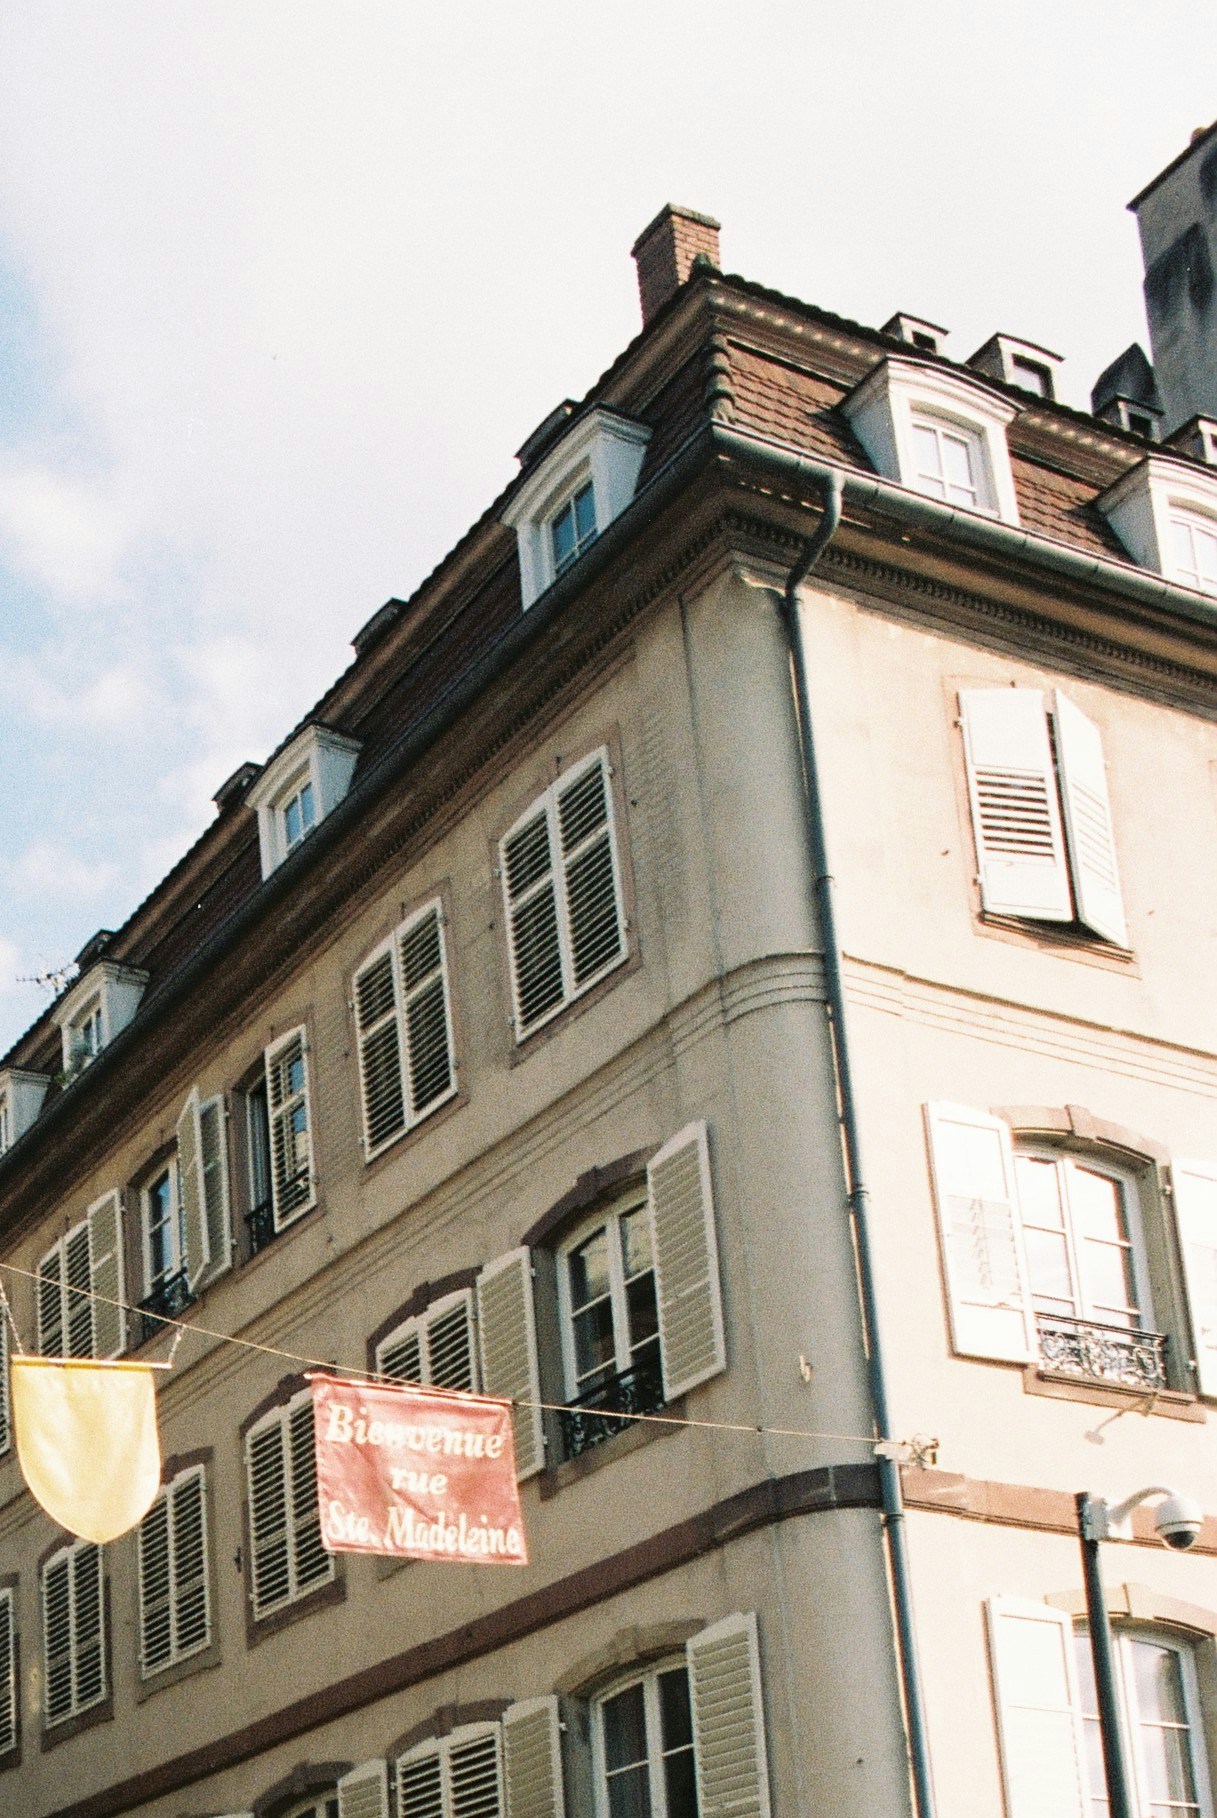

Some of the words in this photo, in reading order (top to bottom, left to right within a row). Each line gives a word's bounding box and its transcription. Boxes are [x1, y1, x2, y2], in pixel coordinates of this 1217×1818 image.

[326, 1403, 505, 1458] Bienvenue
[391, 1467, 448, 1495] rue
[384, 1505, 522, 1555] Madeleine
